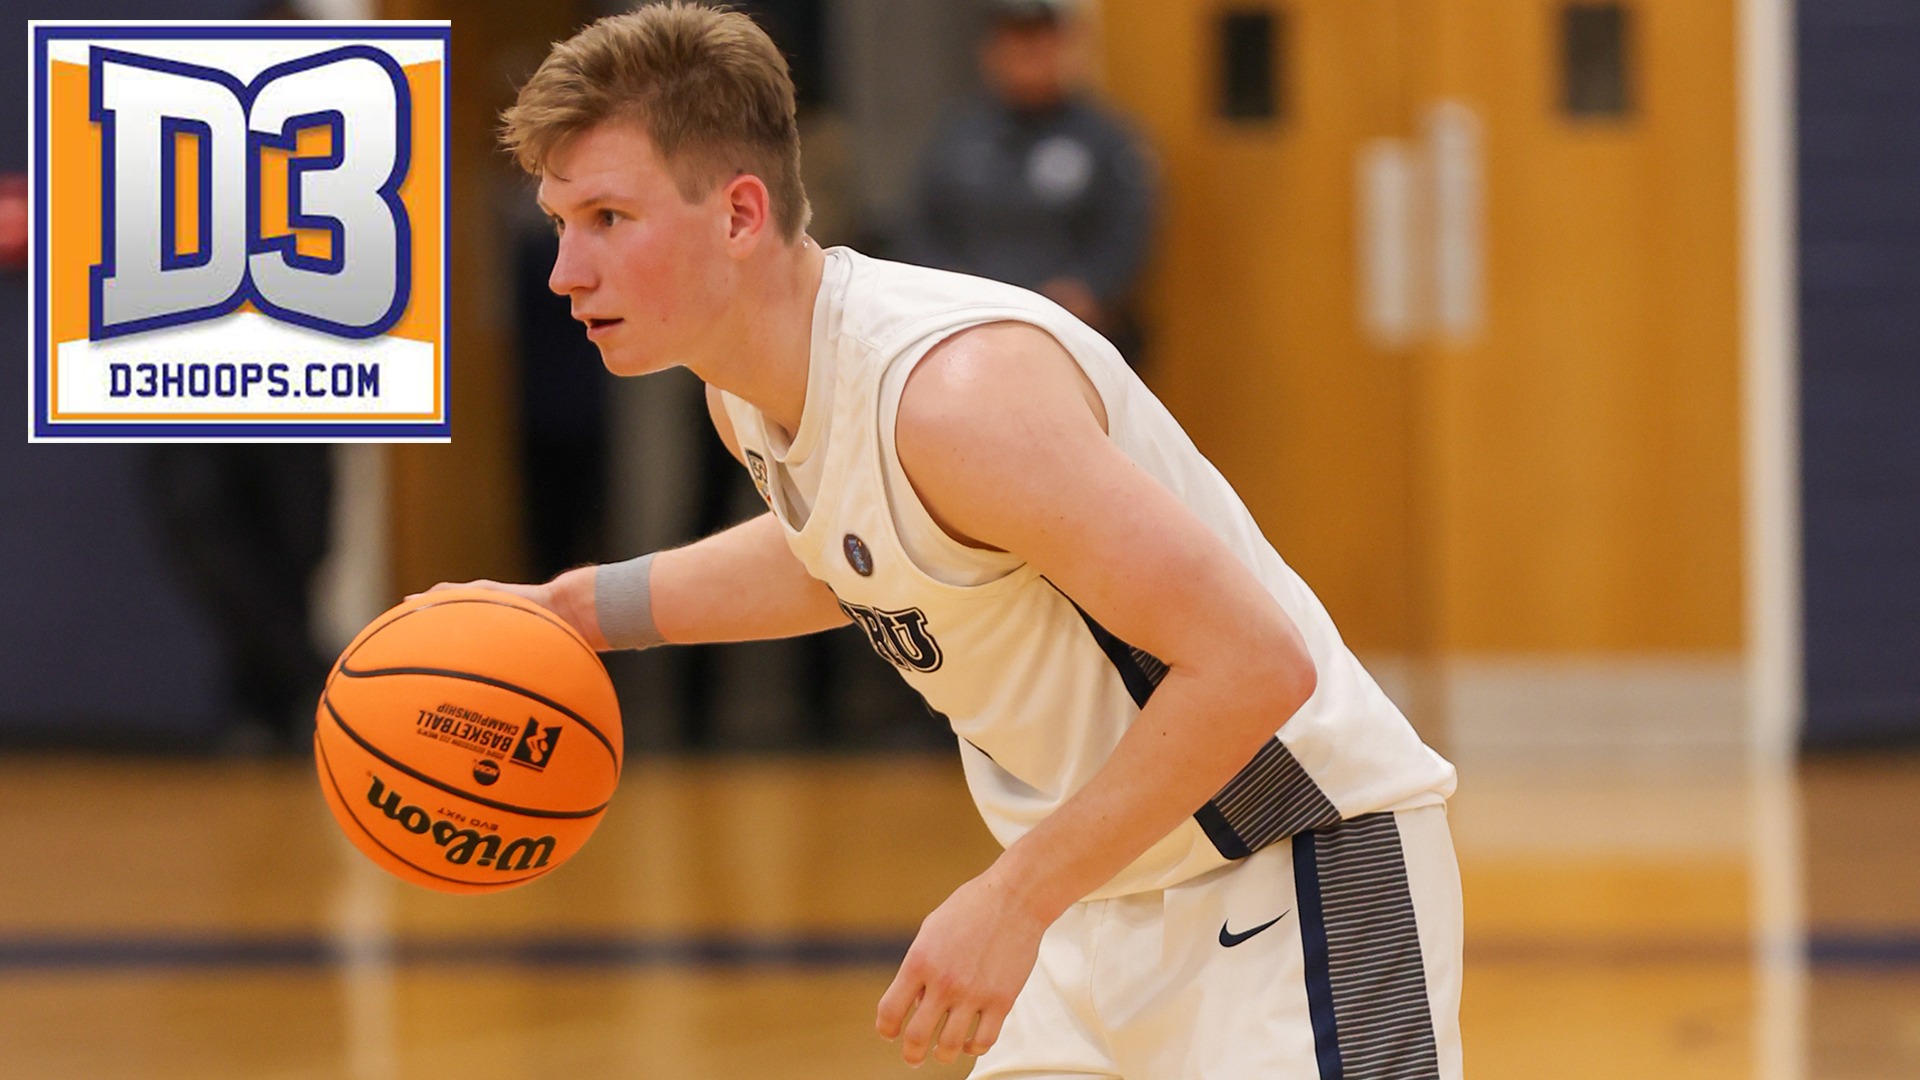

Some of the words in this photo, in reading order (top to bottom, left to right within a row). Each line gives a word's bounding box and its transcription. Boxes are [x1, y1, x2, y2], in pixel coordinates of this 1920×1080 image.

[839, 599, 943, 673] RU
[416, 710, 514, 752] BASKETBALL
[437, 703, 519, 736] CHAMPIONSHIP
[367, 775, 556, 871] Wilson
[438, 807, 466, 822] NXT
[471, 818, 499, 831] EVO
